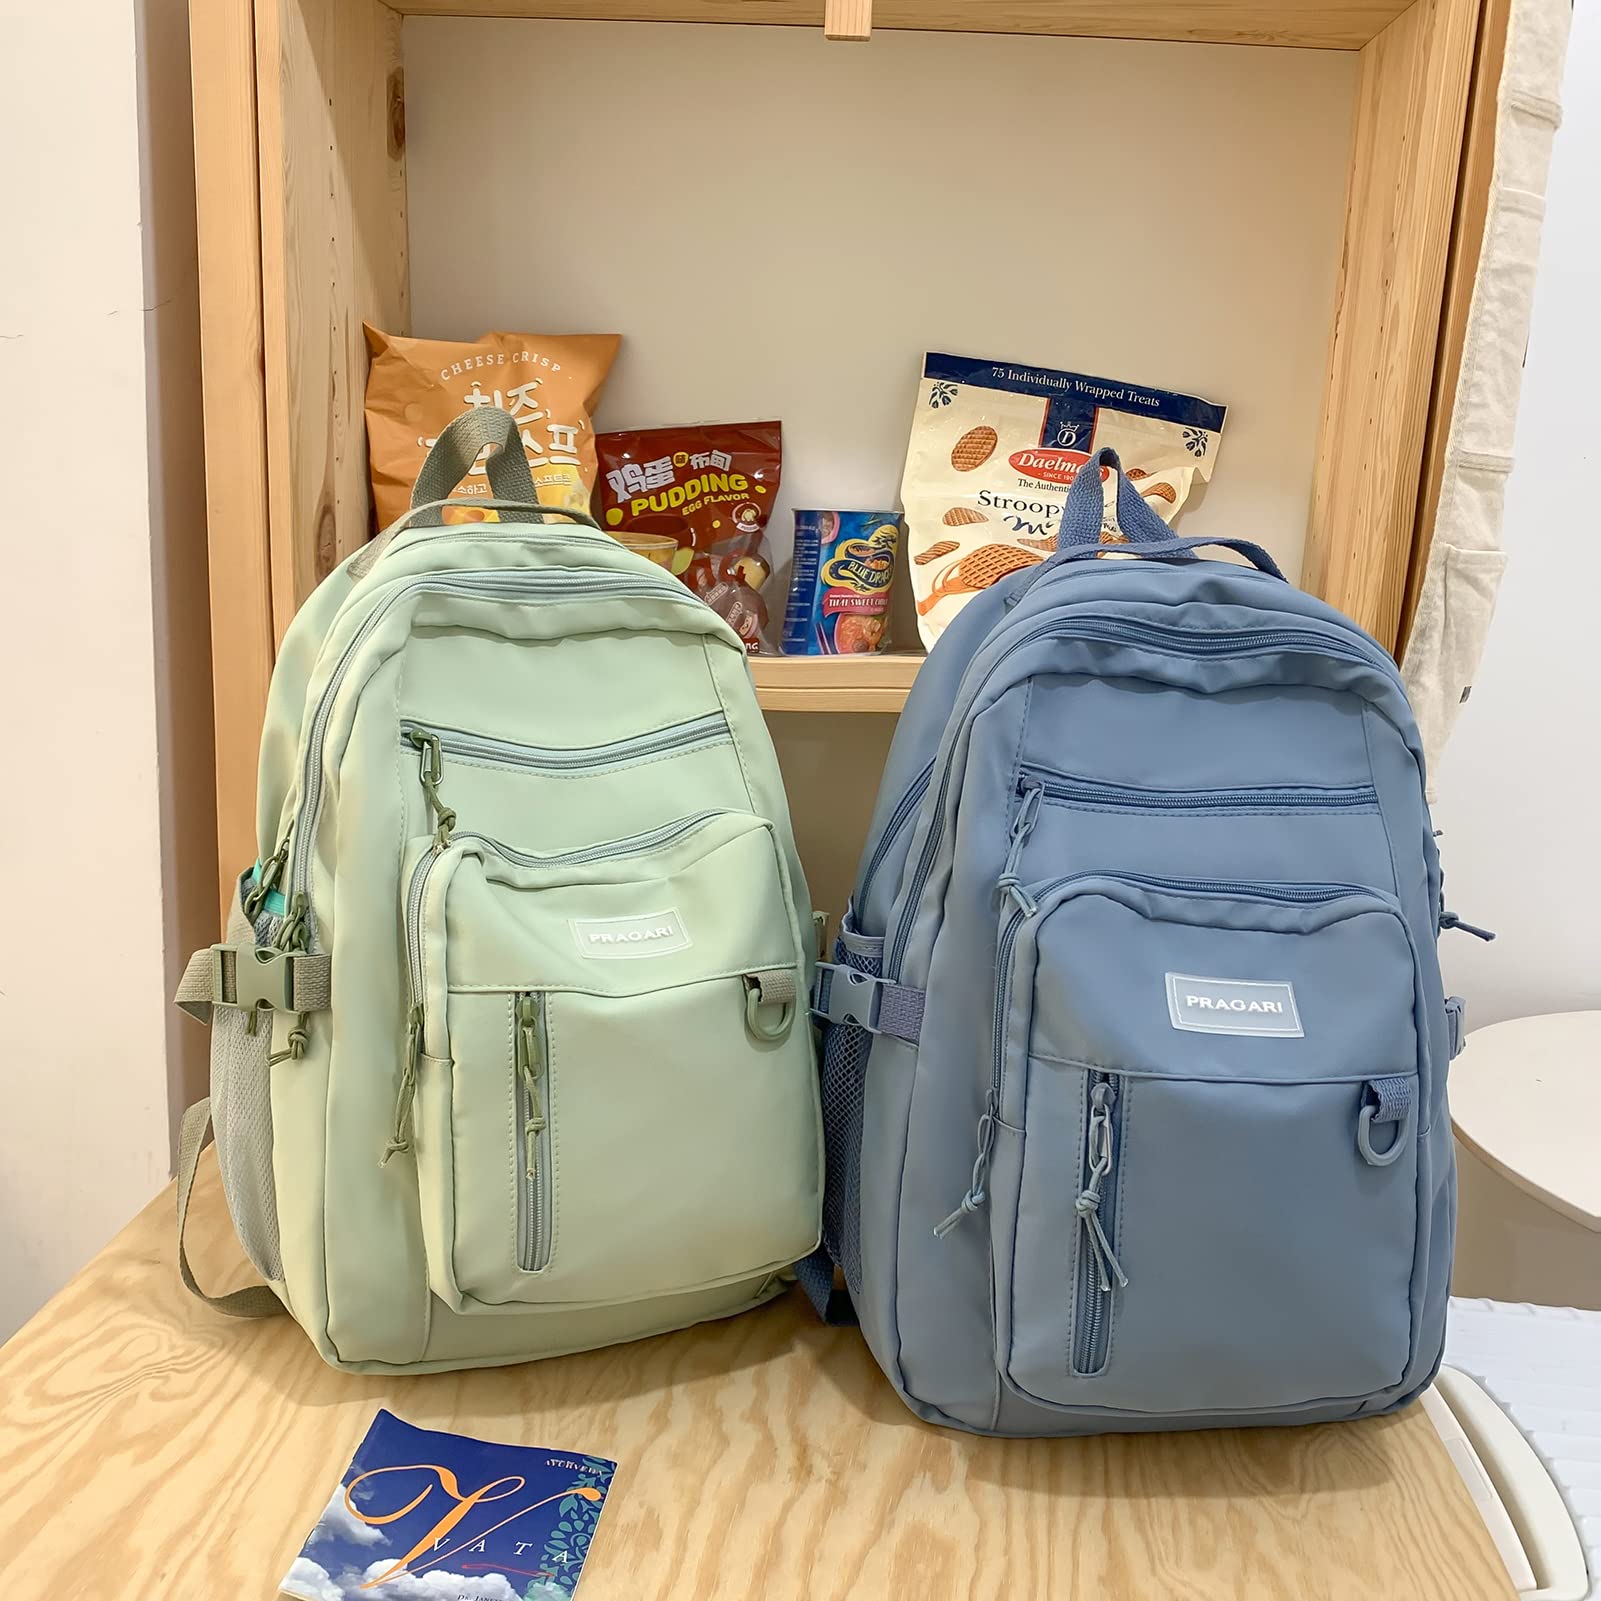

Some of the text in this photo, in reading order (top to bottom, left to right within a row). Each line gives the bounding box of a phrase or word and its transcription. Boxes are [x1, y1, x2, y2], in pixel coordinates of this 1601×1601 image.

[440, 351, 561, 380] CHEESE CRISP
[992, 367, 1160, 407] 75 Individually Wrapped Treats
[1018, 478, 1071, 493] The Authenti
[1043, 472, 1061, 480] SINCE
[452, 483, 488, 495] 소하고
[631, 473, 748, 516] PUDDING
[681, 493, 750, 516] EGG FLAVOR
[978, 490, 1064, 518] Stroop
[847, 561, 870, 581] BLUE
[432, 1538, 569, 1563] VATA
